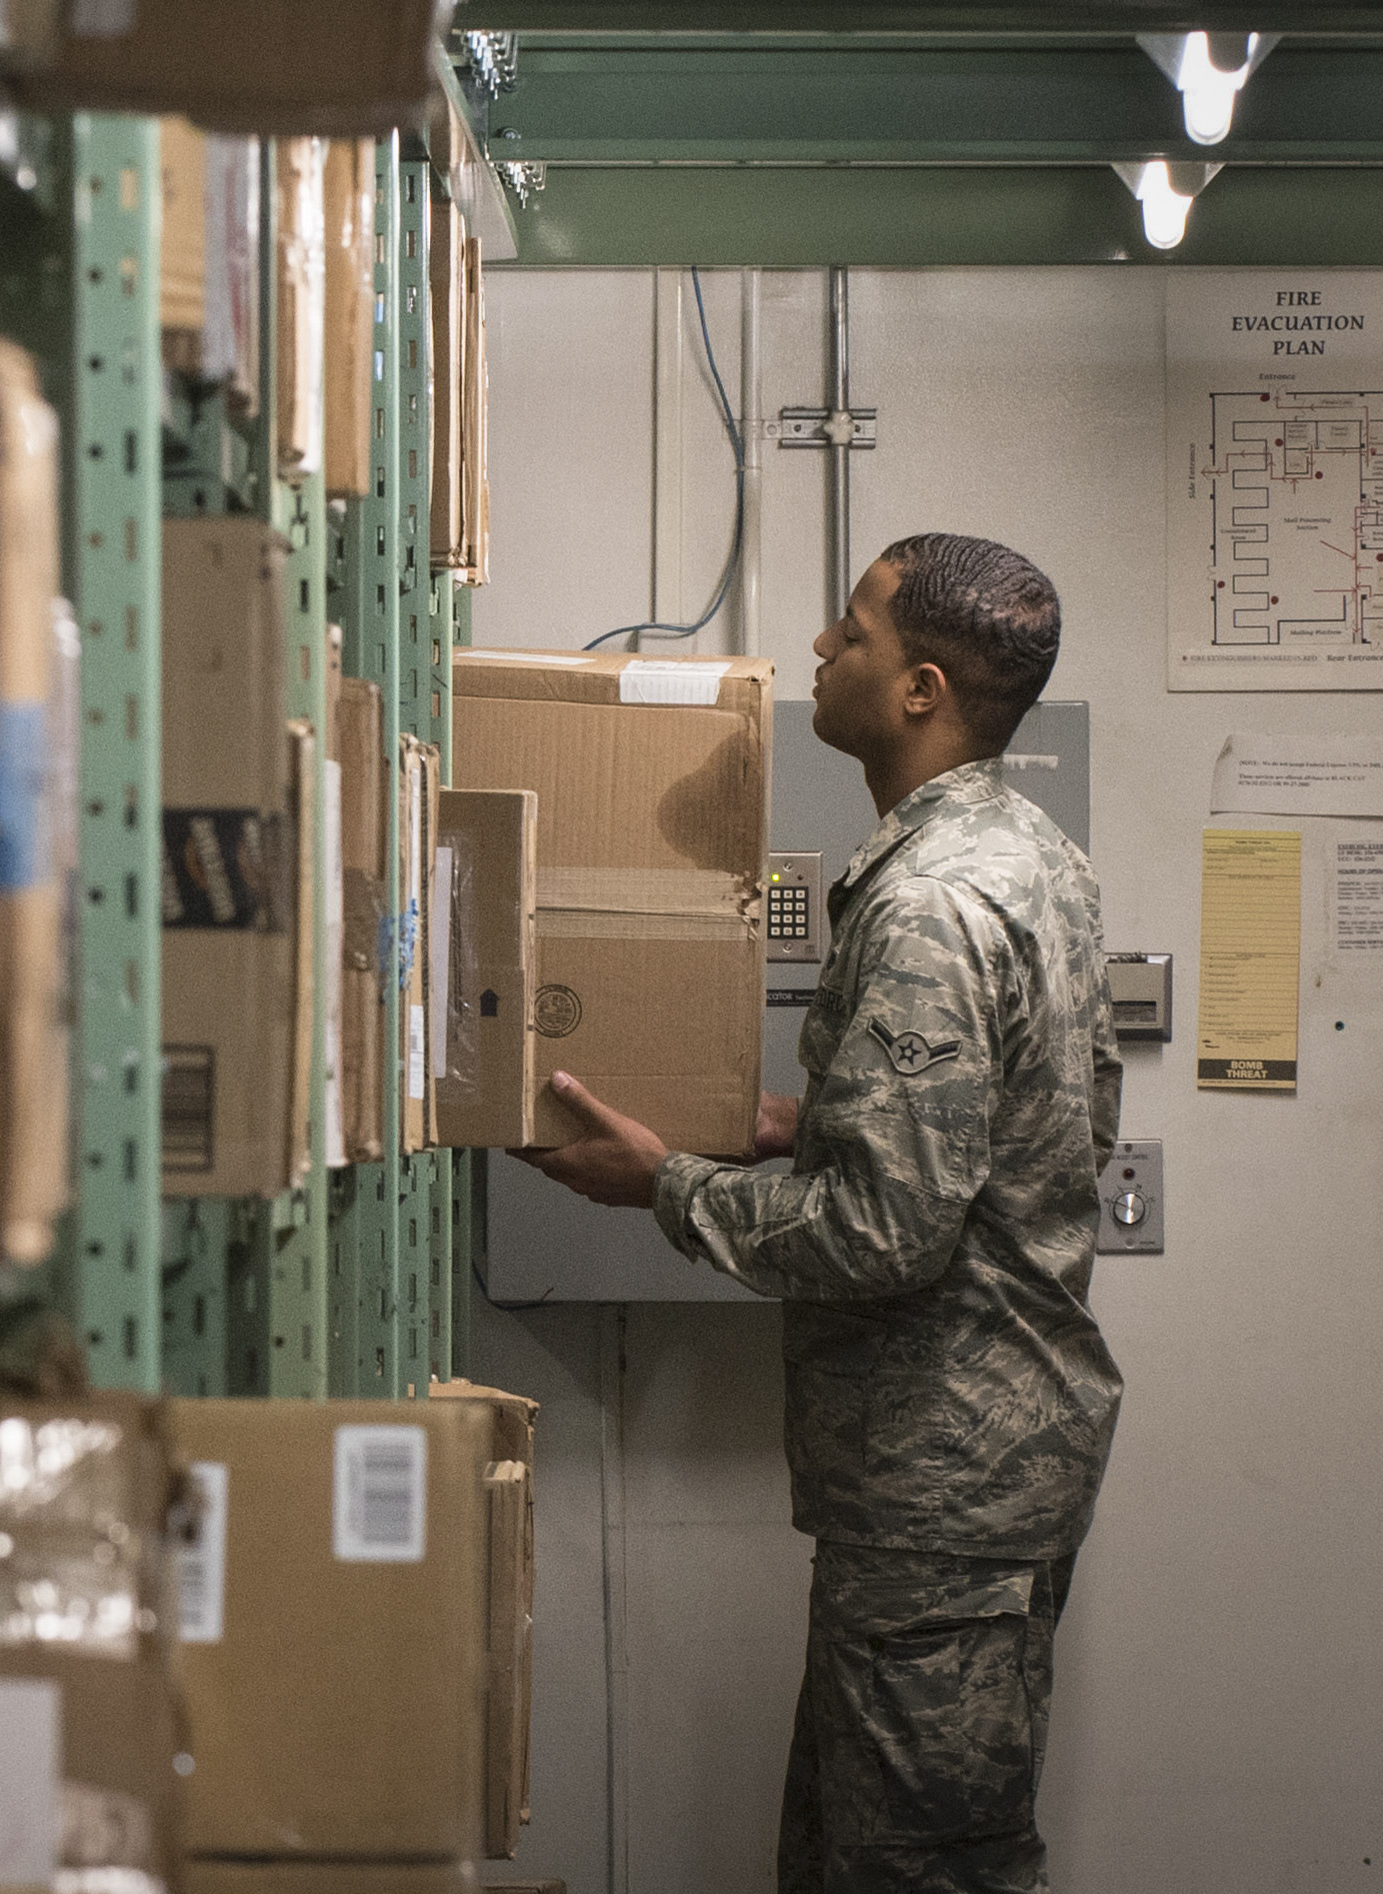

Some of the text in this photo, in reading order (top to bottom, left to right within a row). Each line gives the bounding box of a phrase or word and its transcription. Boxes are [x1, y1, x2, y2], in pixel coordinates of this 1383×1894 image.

[1276, 291, 1322, 306] FIRE
[1232, 315, 1365, 331] EVACUATION
[1273, 340, 1325, 355] PLAN
[1231, 1061, 1263, 1070] BOMB
[1226, 1070, 1268, 1078] THREAT
